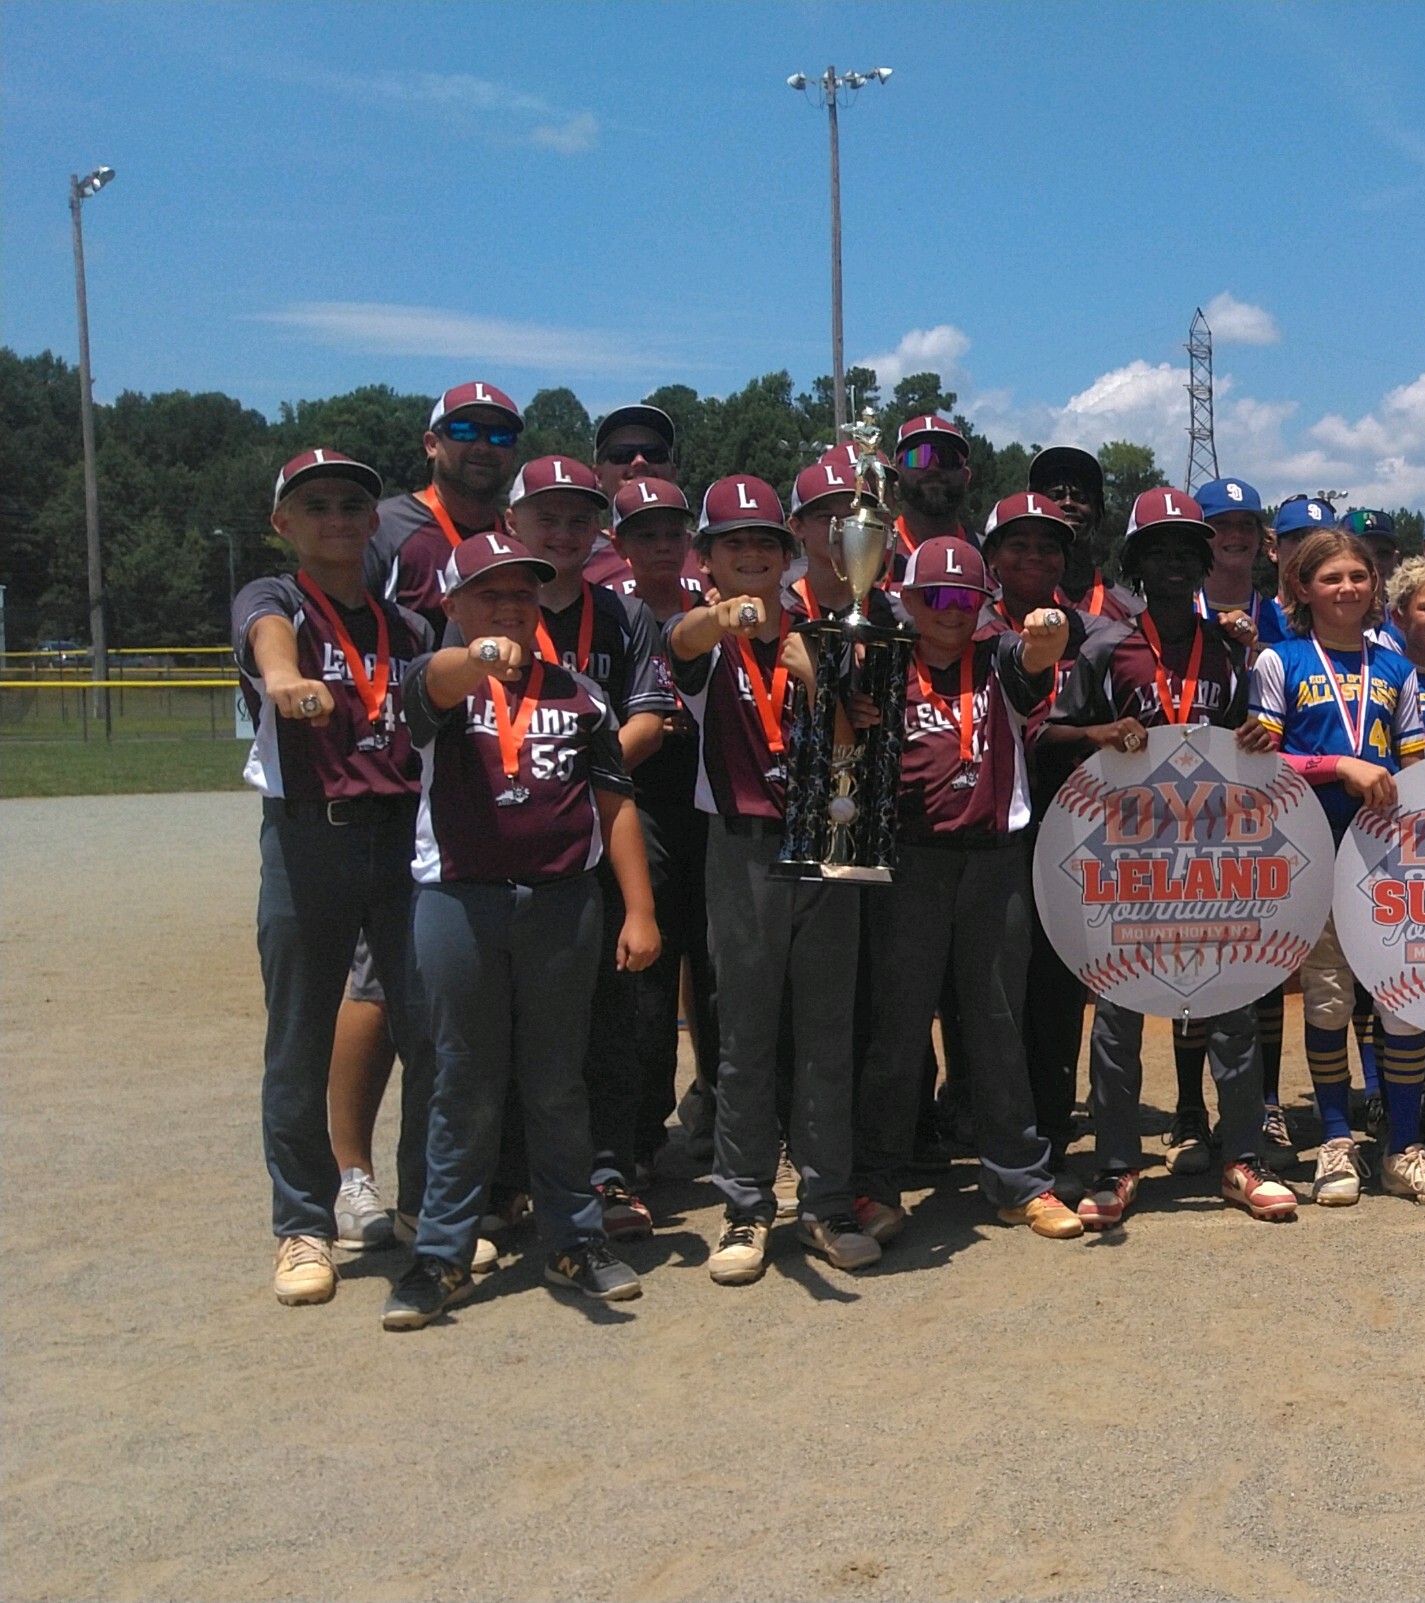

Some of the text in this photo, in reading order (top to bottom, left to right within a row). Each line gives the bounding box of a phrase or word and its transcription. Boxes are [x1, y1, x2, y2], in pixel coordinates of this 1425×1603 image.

[475, 382, 493, 402] L
[925, 416, 939, 430] L
[553, 461, 573, 484] L
[824, 465, 845, 486] L
[638, 481, 658, 503] L
[737, 483, 758, 510] L
[1027, 494, 1042, 514] L
[1163, 493, 1182, 516] L
[486, 533, 514, 555] L
[945, 548, 963, 575] L
[1103, 781, 1275, 846] DYB
[1082, 857, 1291, 905] LELAND
[1121, 926, 1174, 940] MOUNT
